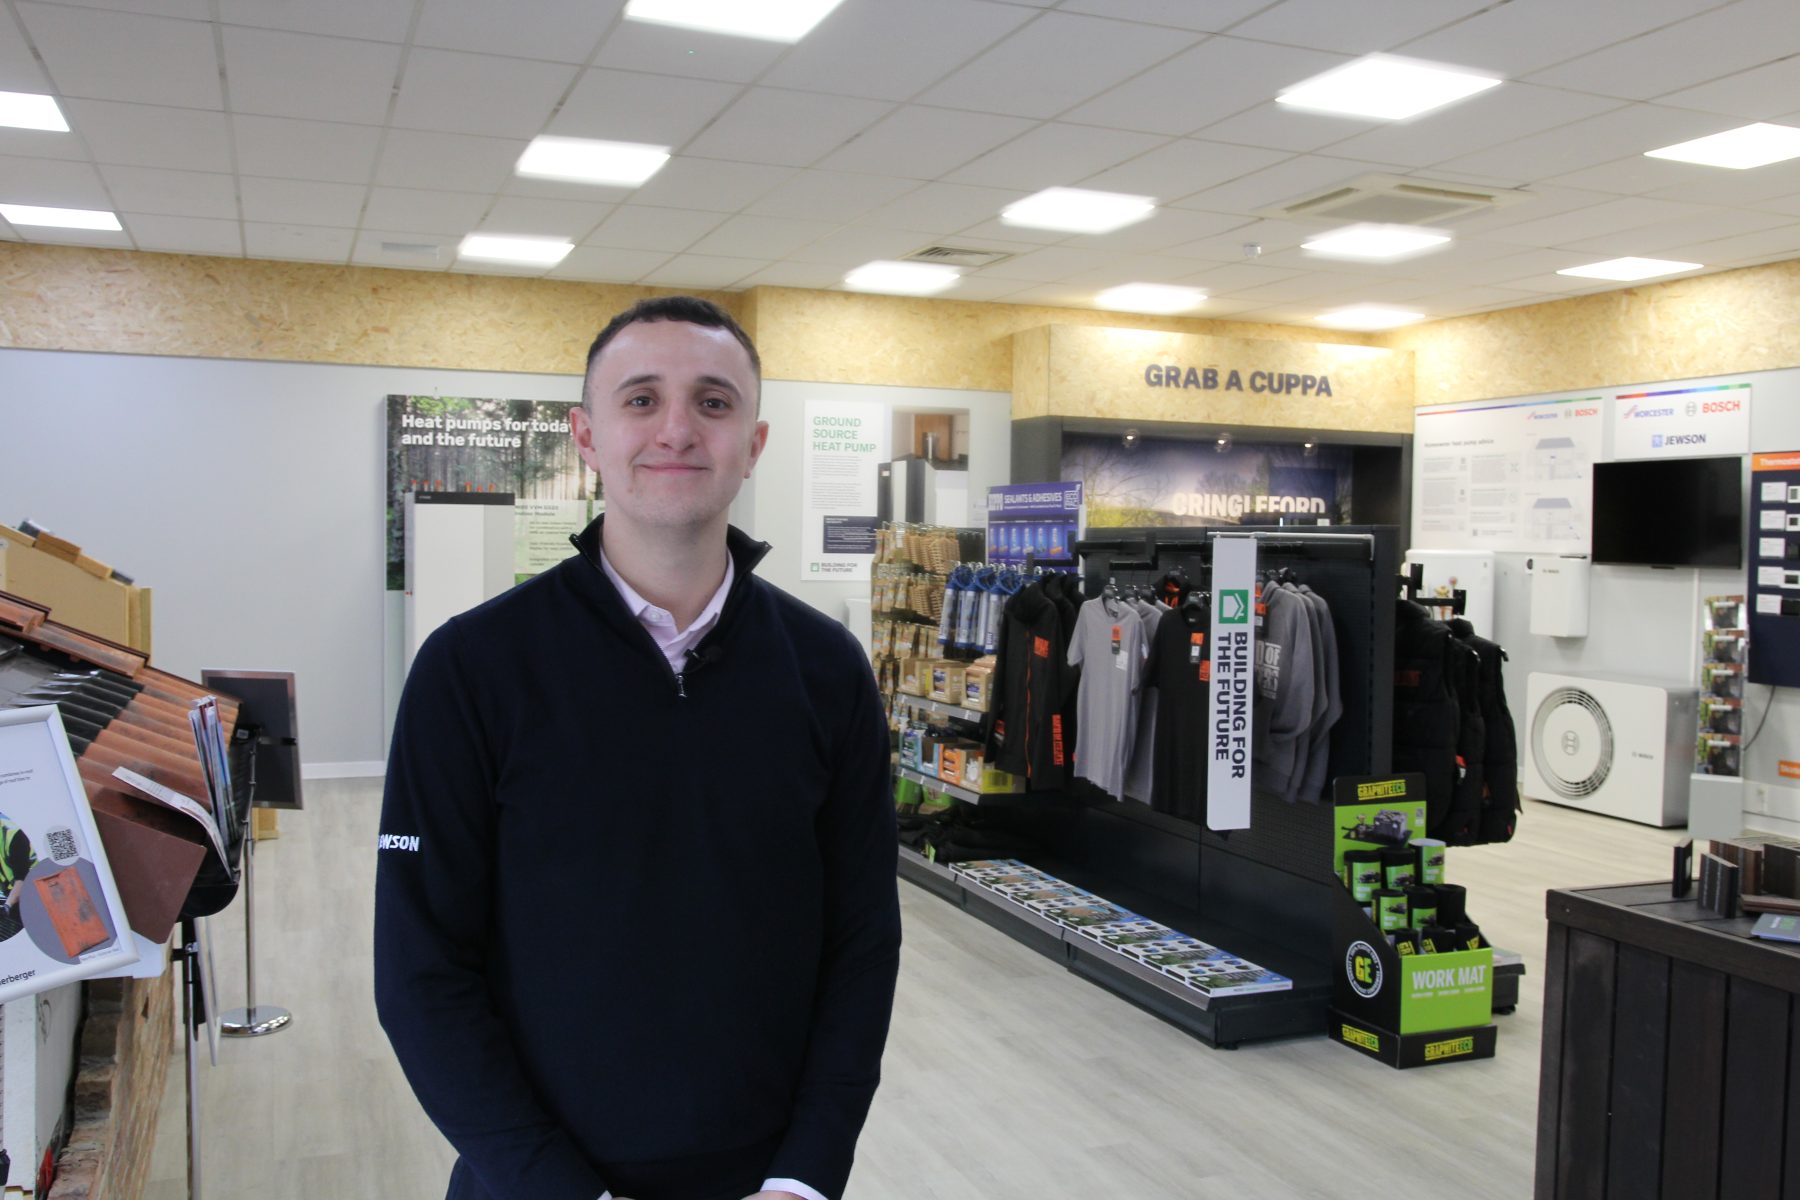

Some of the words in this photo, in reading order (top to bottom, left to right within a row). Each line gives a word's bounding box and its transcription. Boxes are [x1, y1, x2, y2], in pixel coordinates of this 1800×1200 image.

[1145, 364, 1219, 389] GRAB
[1225, 369, 1244, 392] A
[1250, 370, 1332, 397] CUPPA
[1702, 400, 1741, 413] BOSCH
[402, 415, 443, 429] Heat
[445, 417, 502, 433] pumps
[505, 418, 530, 431] for
[813, 416, 862, 428] GROUND
[401, 433, 433, 446] and
[436, 433, 465, 446] the
[467, 434, 522, 448] future
[813, 428, 858, 440] SOURCE
[1665, 434, 1707, 446] JEWSON
[813, 441, 842, 452] HEAT
[844, 443, 877, 453] PUMP
[1216, 632, 1232, 673] THE
[1232, 632, 1248, 732] BUILDING
[1215, 679, 1231, 761] FUTURE
[1231, 736, 1246, 779] FOR
[1355, 955, 1373, 984] GE
[1412, 969, 1456, 990] WORK
[1458, 965, 1487, 985] MAT
